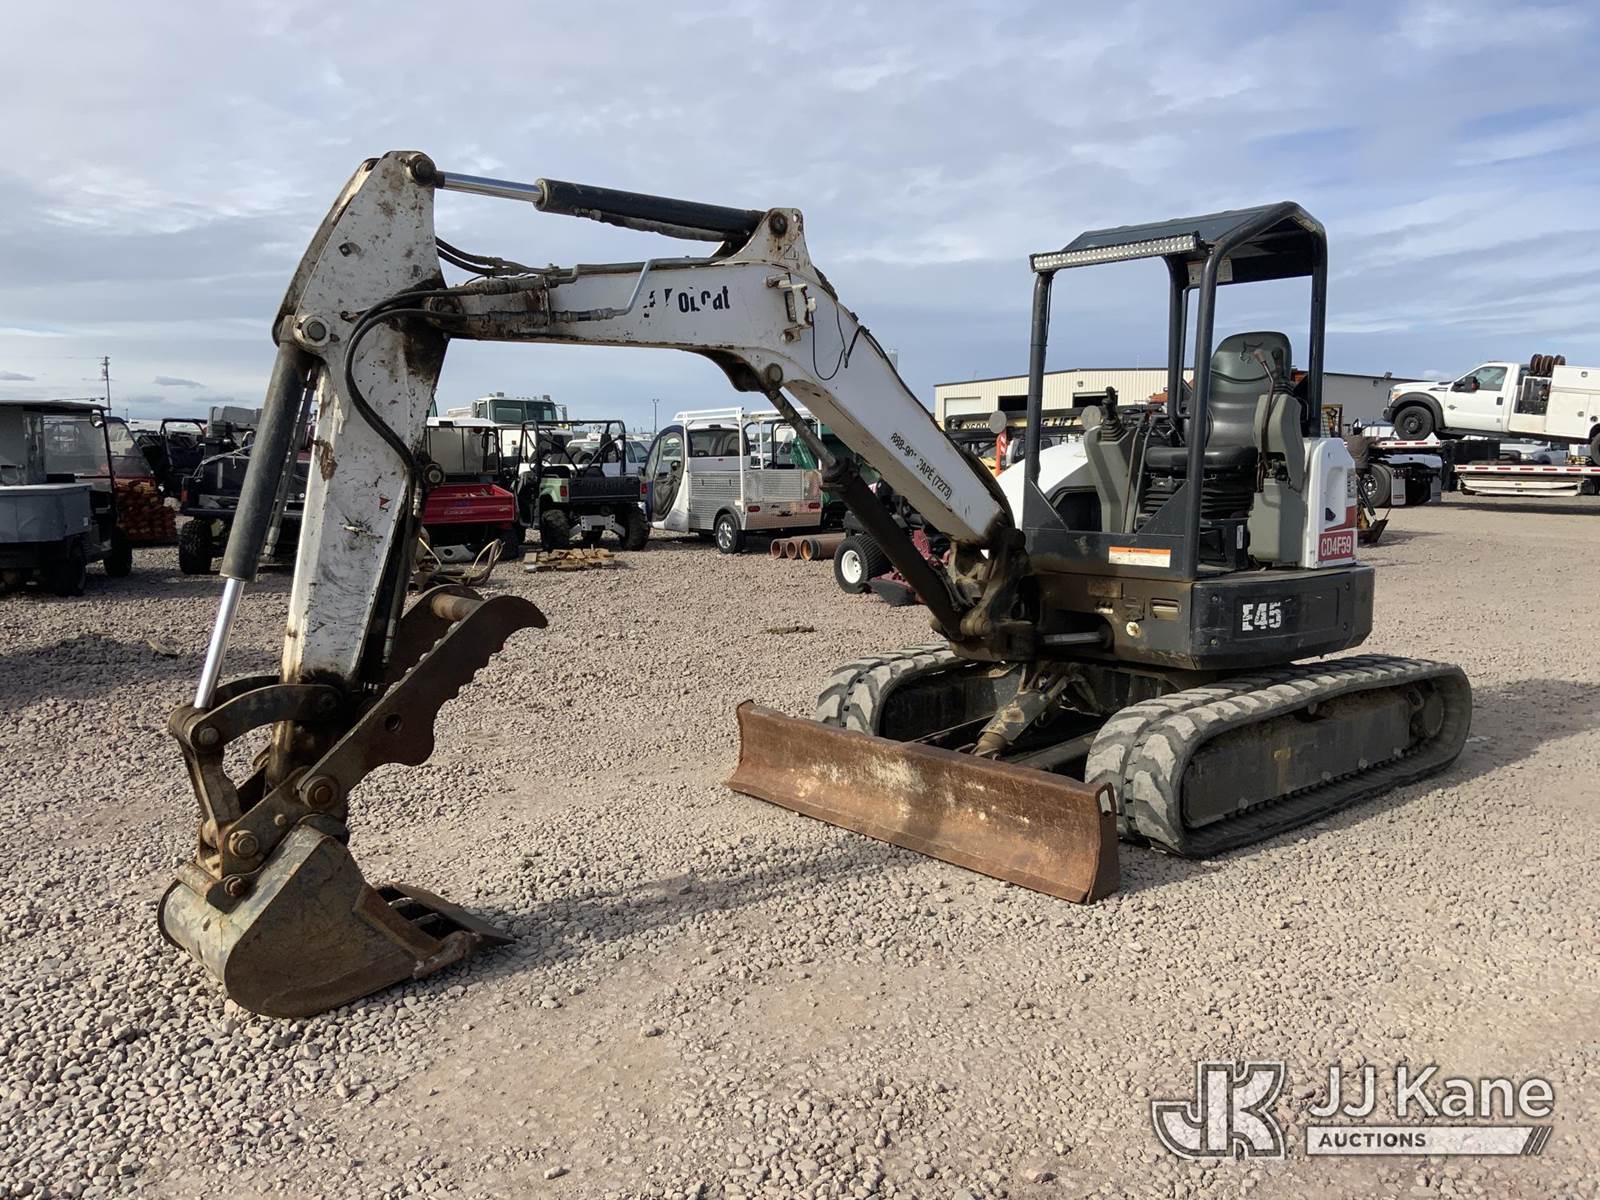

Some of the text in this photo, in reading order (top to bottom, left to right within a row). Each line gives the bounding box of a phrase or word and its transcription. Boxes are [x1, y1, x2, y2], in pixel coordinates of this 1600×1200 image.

[931, 474, 953, 501] (7273)
[1321, 535, 1352, 557] CD4F59
[1242, 602, 1281, 631] E45
